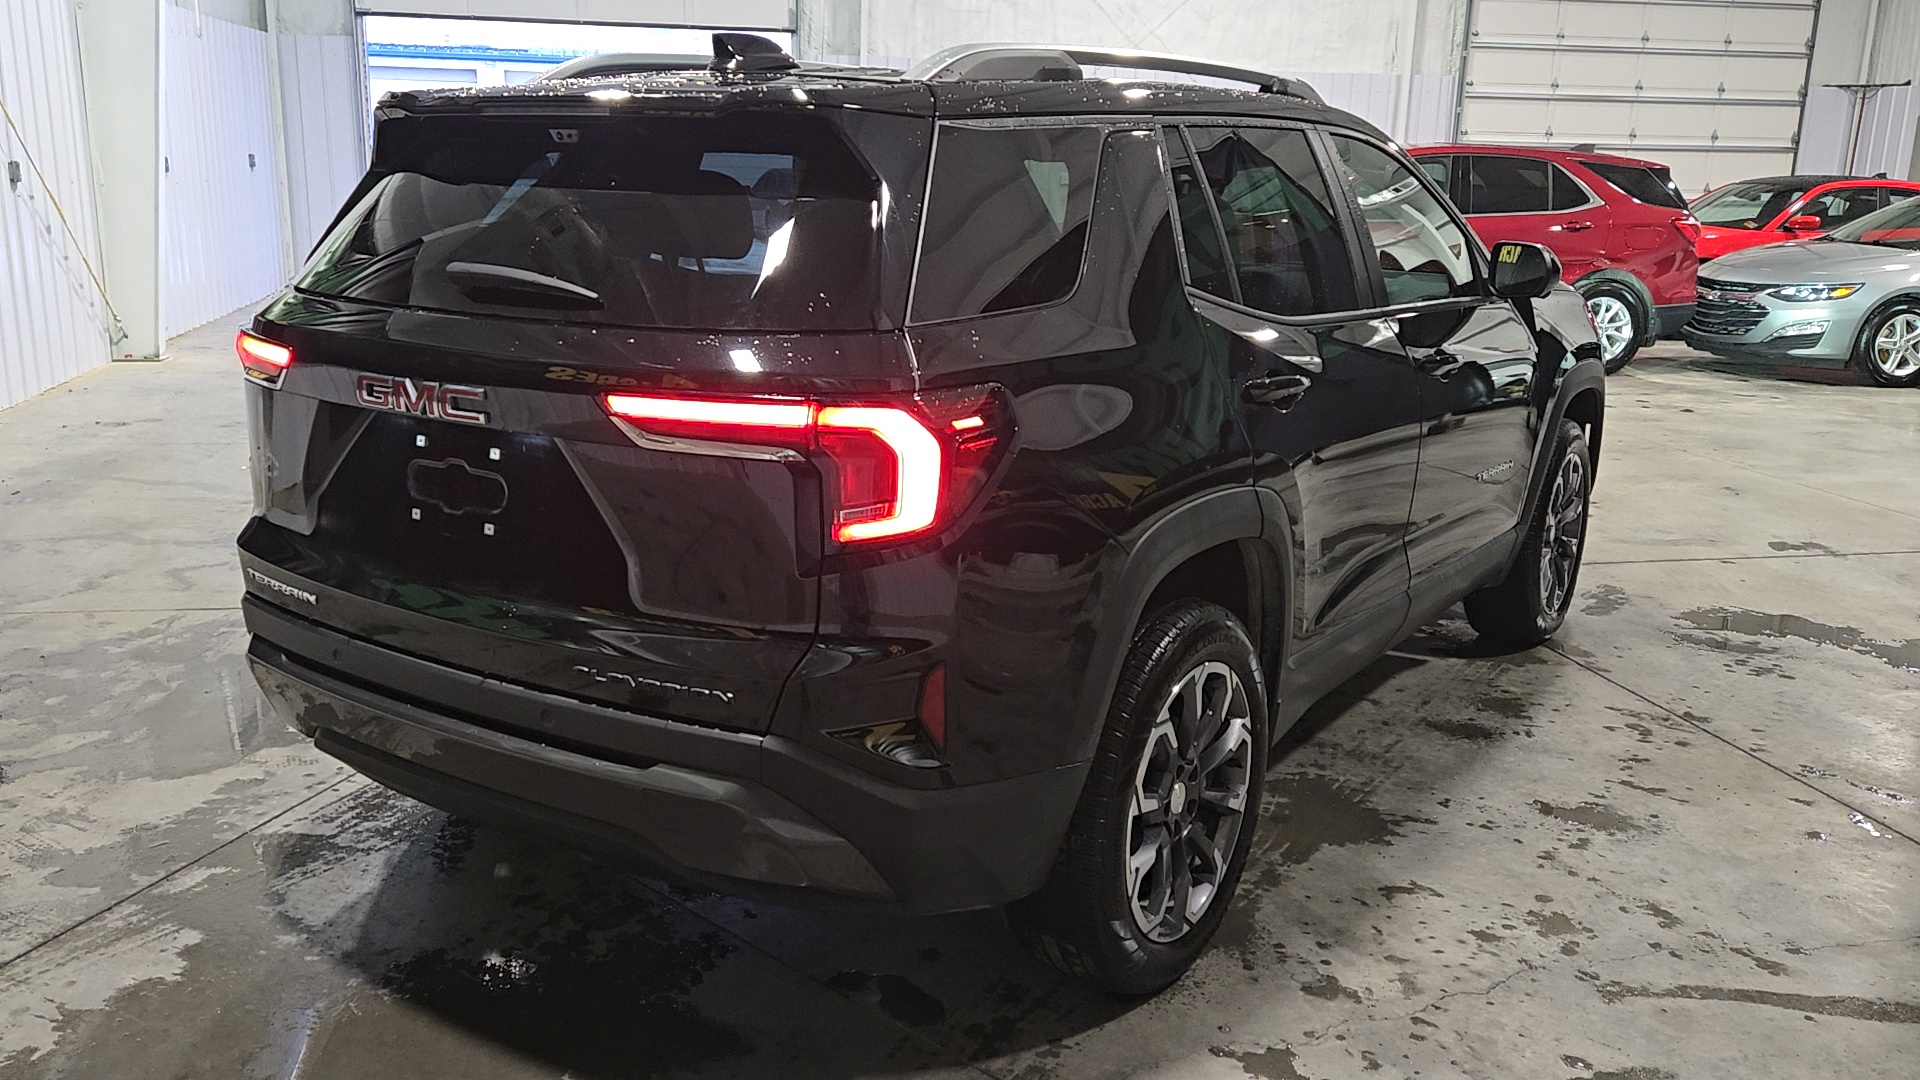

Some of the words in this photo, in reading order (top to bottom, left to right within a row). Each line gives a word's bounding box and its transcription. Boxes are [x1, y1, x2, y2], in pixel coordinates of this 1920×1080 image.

[356, 372, 488, 425] GMC
[1476, 459, 1515, 482] TERRAIN
[246, 567, 317, 605] TERRAIN
